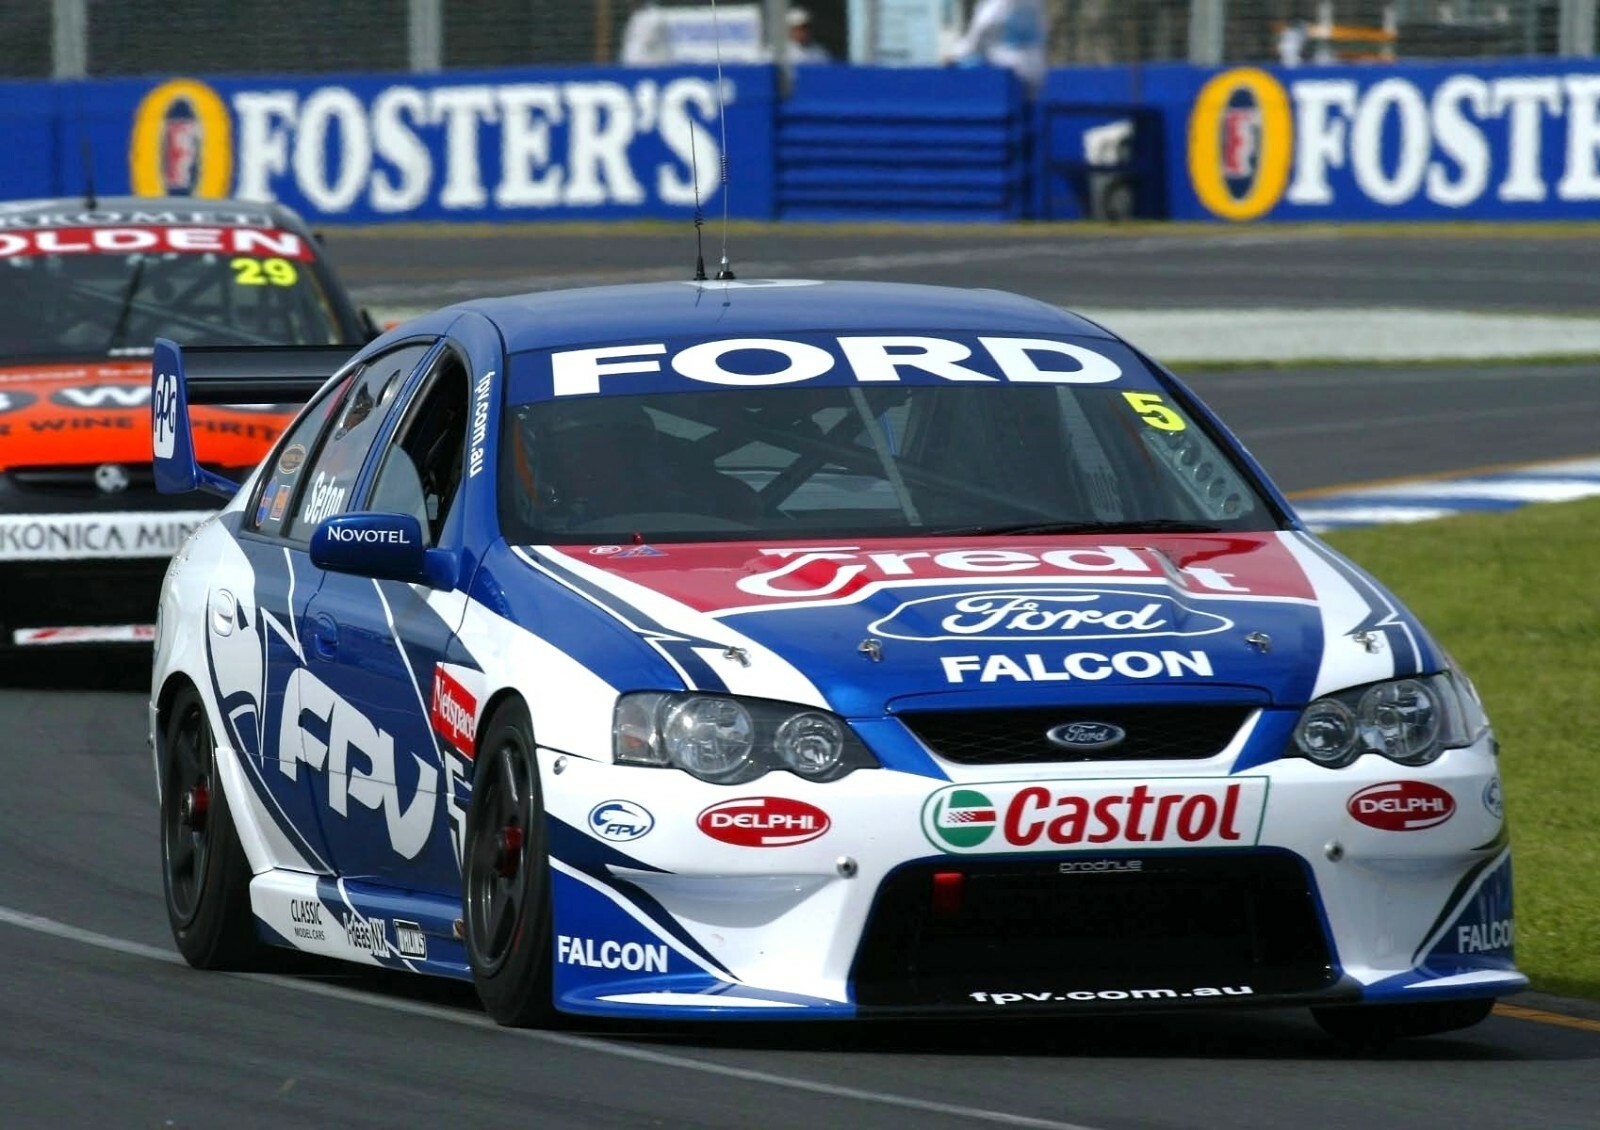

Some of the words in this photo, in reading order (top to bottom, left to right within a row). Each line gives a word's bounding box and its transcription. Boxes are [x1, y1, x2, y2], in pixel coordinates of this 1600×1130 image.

[232, 77, 719, 212] FOSTER'S
[230, 257, 297, 286] 29
[551, 336, 1122, 396] FORD
[29, 416, 134, 432] WINE
[469, 371, 495, 478] fpv.com.au
[1121, 392, 1186, 431] 5
[1, 524, 125, 551] KONICA
[327, 526, 410, 544] NOVOTEL
[941, 595, 1168, 633] Ford
[940, 650, 1213, 683] FALCON
[432, 675, 475, 742] Netspace
[1064, 724, 1109, 742] Ford
[279, 667, 438, 860] FPV
[1004, 784, 1241, 847] Castrol
[1359, 797, 1445, 814] DELPHI
[604, 823, 648, 836] FPV
[711, 813, 815, 830] DELPHI
[291, 899, 322, 925] CLASSIC
[295, 928, 312, 940] MODEL
[312, 929, 325, 941] CARS
[1458, 919, 1514, 954] FALCO
[558, 935, 668, 973] FALCON
[969, 985, 1254, 1005] fpv.com.au
